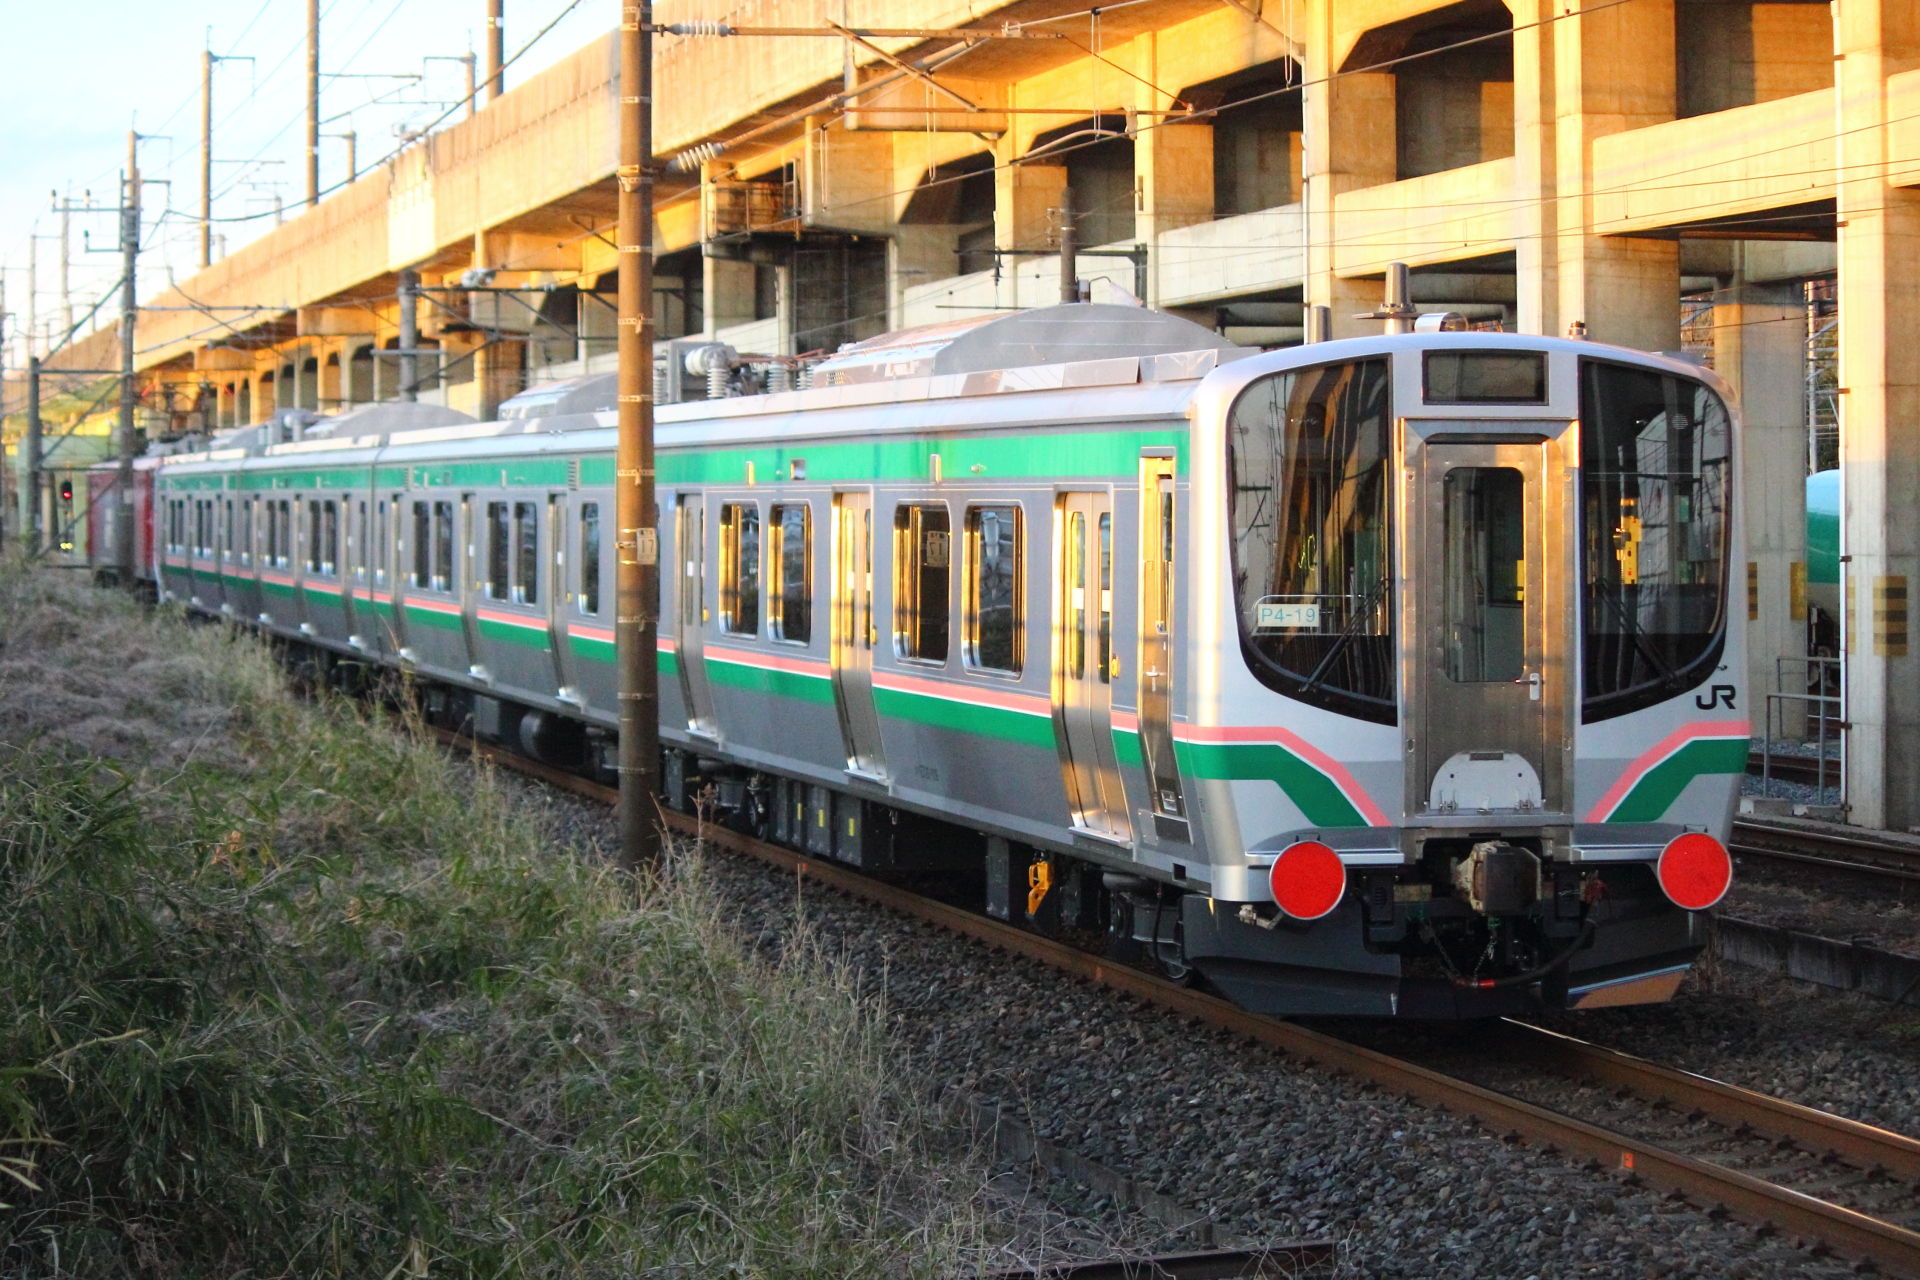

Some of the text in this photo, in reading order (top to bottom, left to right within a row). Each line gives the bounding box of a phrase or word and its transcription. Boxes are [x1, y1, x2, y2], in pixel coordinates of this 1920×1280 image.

[642, 539, 654, 553] 17
[1261, 607, 1316, 622] P4-19
[1695, 684, 1736, 710] JR
